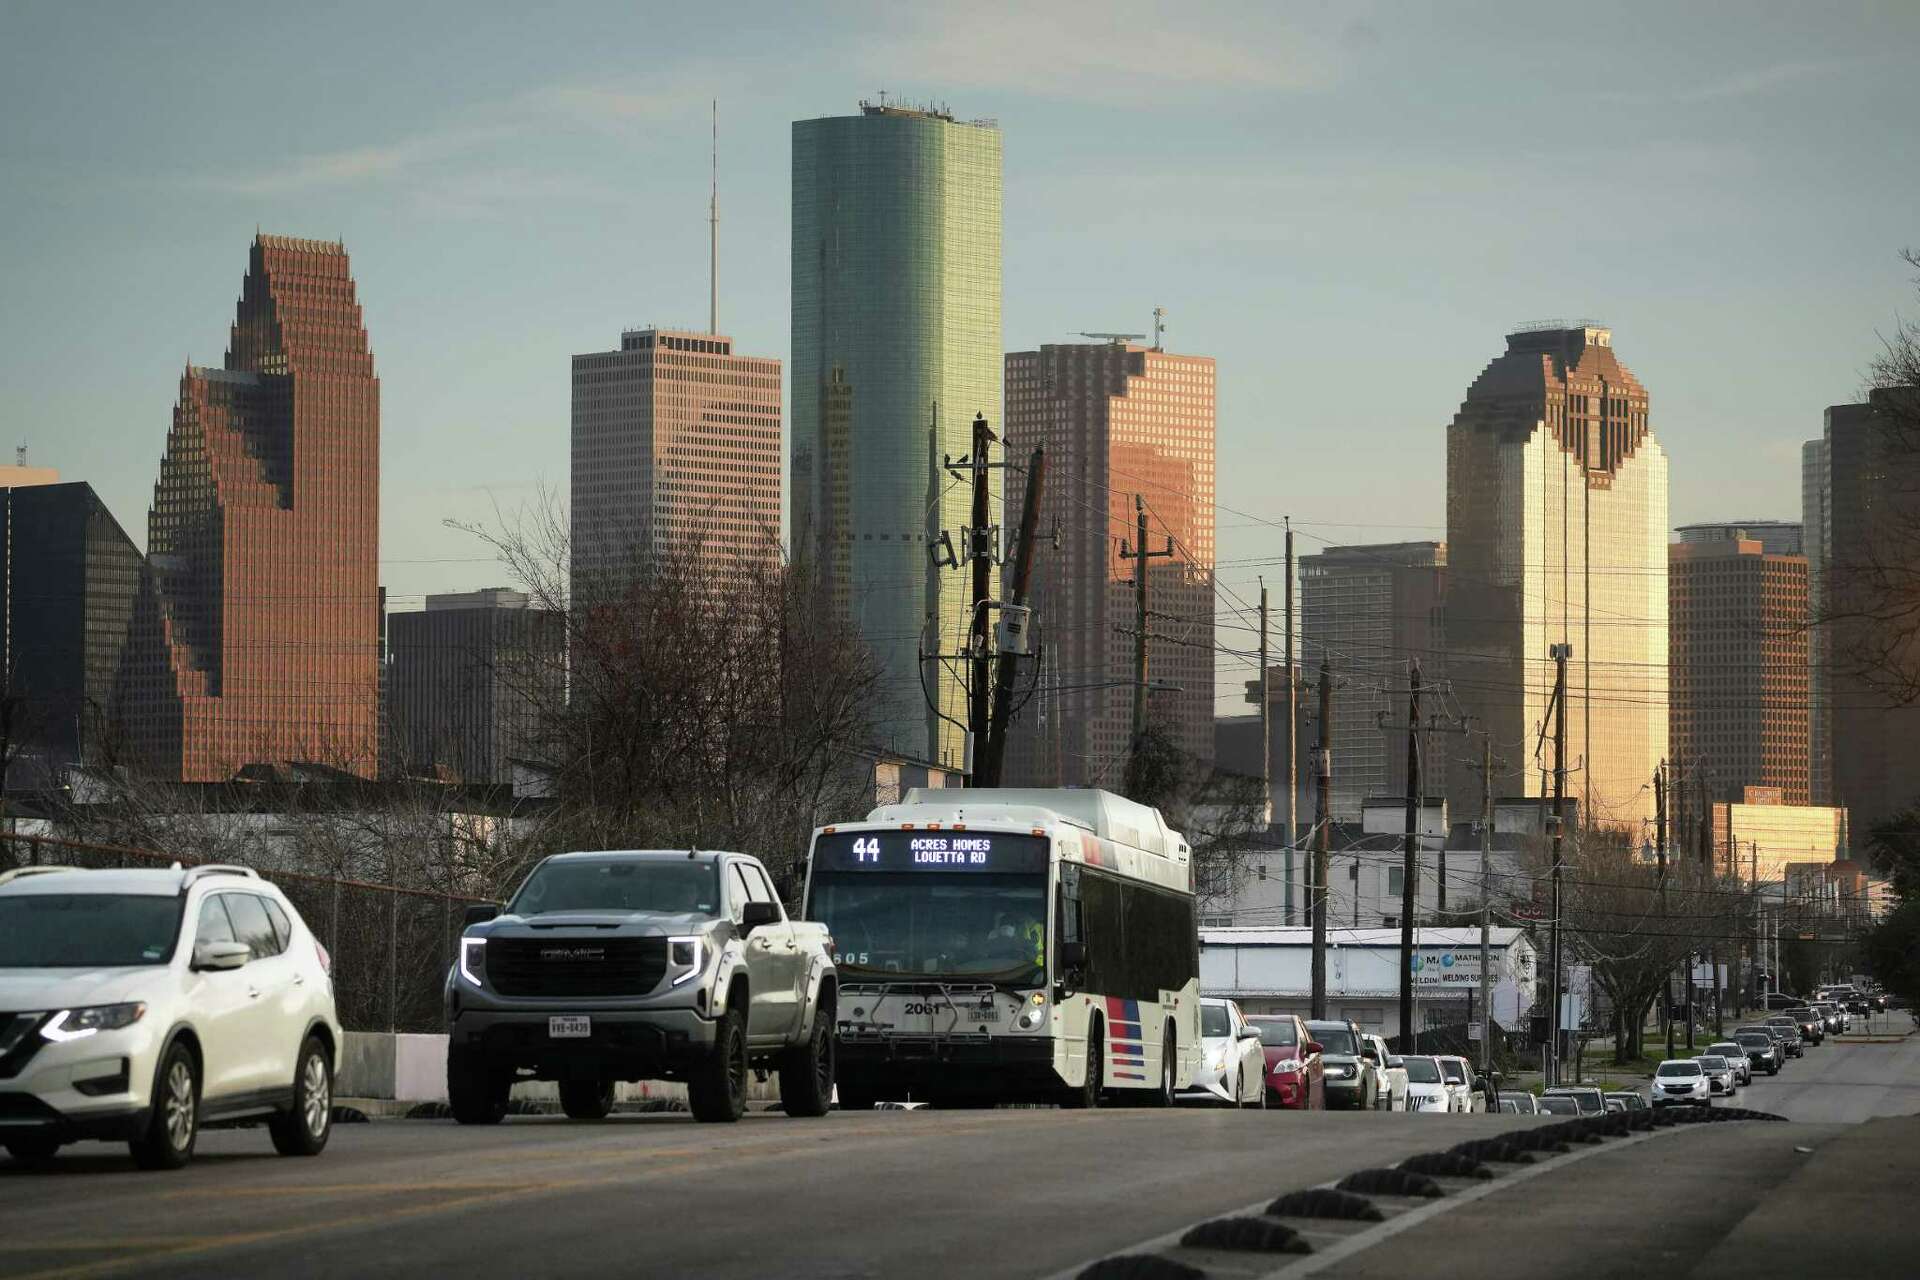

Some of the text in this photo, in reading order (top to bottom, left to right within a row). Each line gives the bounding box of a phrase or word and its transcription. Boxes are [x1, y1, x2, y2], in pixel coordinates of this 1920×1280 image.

[853, 837, 880, 862] 44
[911, 839, 991, 851] ACRES HOMES
[914, 852, 986, 863] LOUETTA RD
[1442, 973, 1469, 983] WELDING
[904, 1002, 940, 1015] 2061
